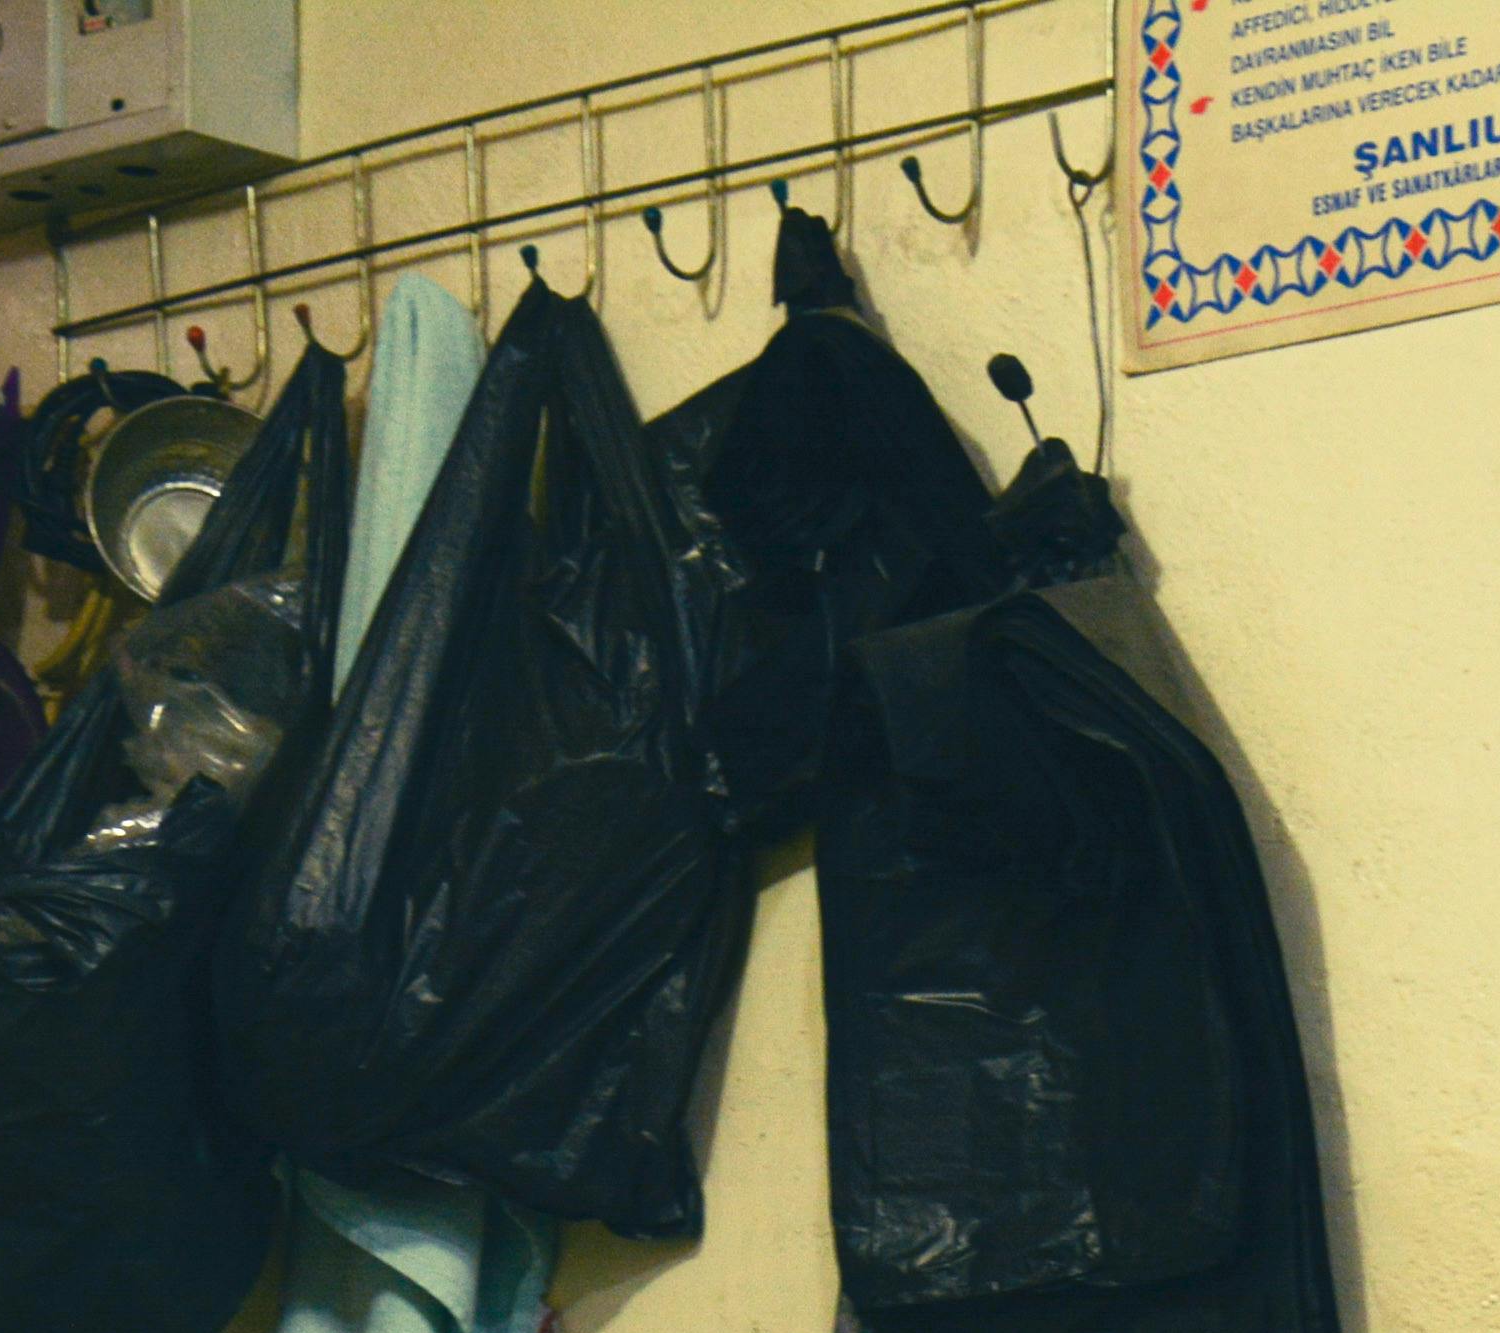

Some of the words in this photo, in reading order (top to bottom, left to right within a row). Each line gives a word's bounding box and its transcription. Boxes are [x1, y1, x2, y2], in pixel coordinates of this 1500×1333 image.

[1231, 27, 1362, 74] DAVRANMASINI
[1367, 18, 1396, 42] BİL
[1301, 58, 1375, 92] MUHTAÇ
[1427, 36, 1469, 63] BİLE
[1358, 79, 1441, 114] VERECEK
[1312, 187, 1362, 216] ESNAF
[1367, 181, 1388, 205] VE
